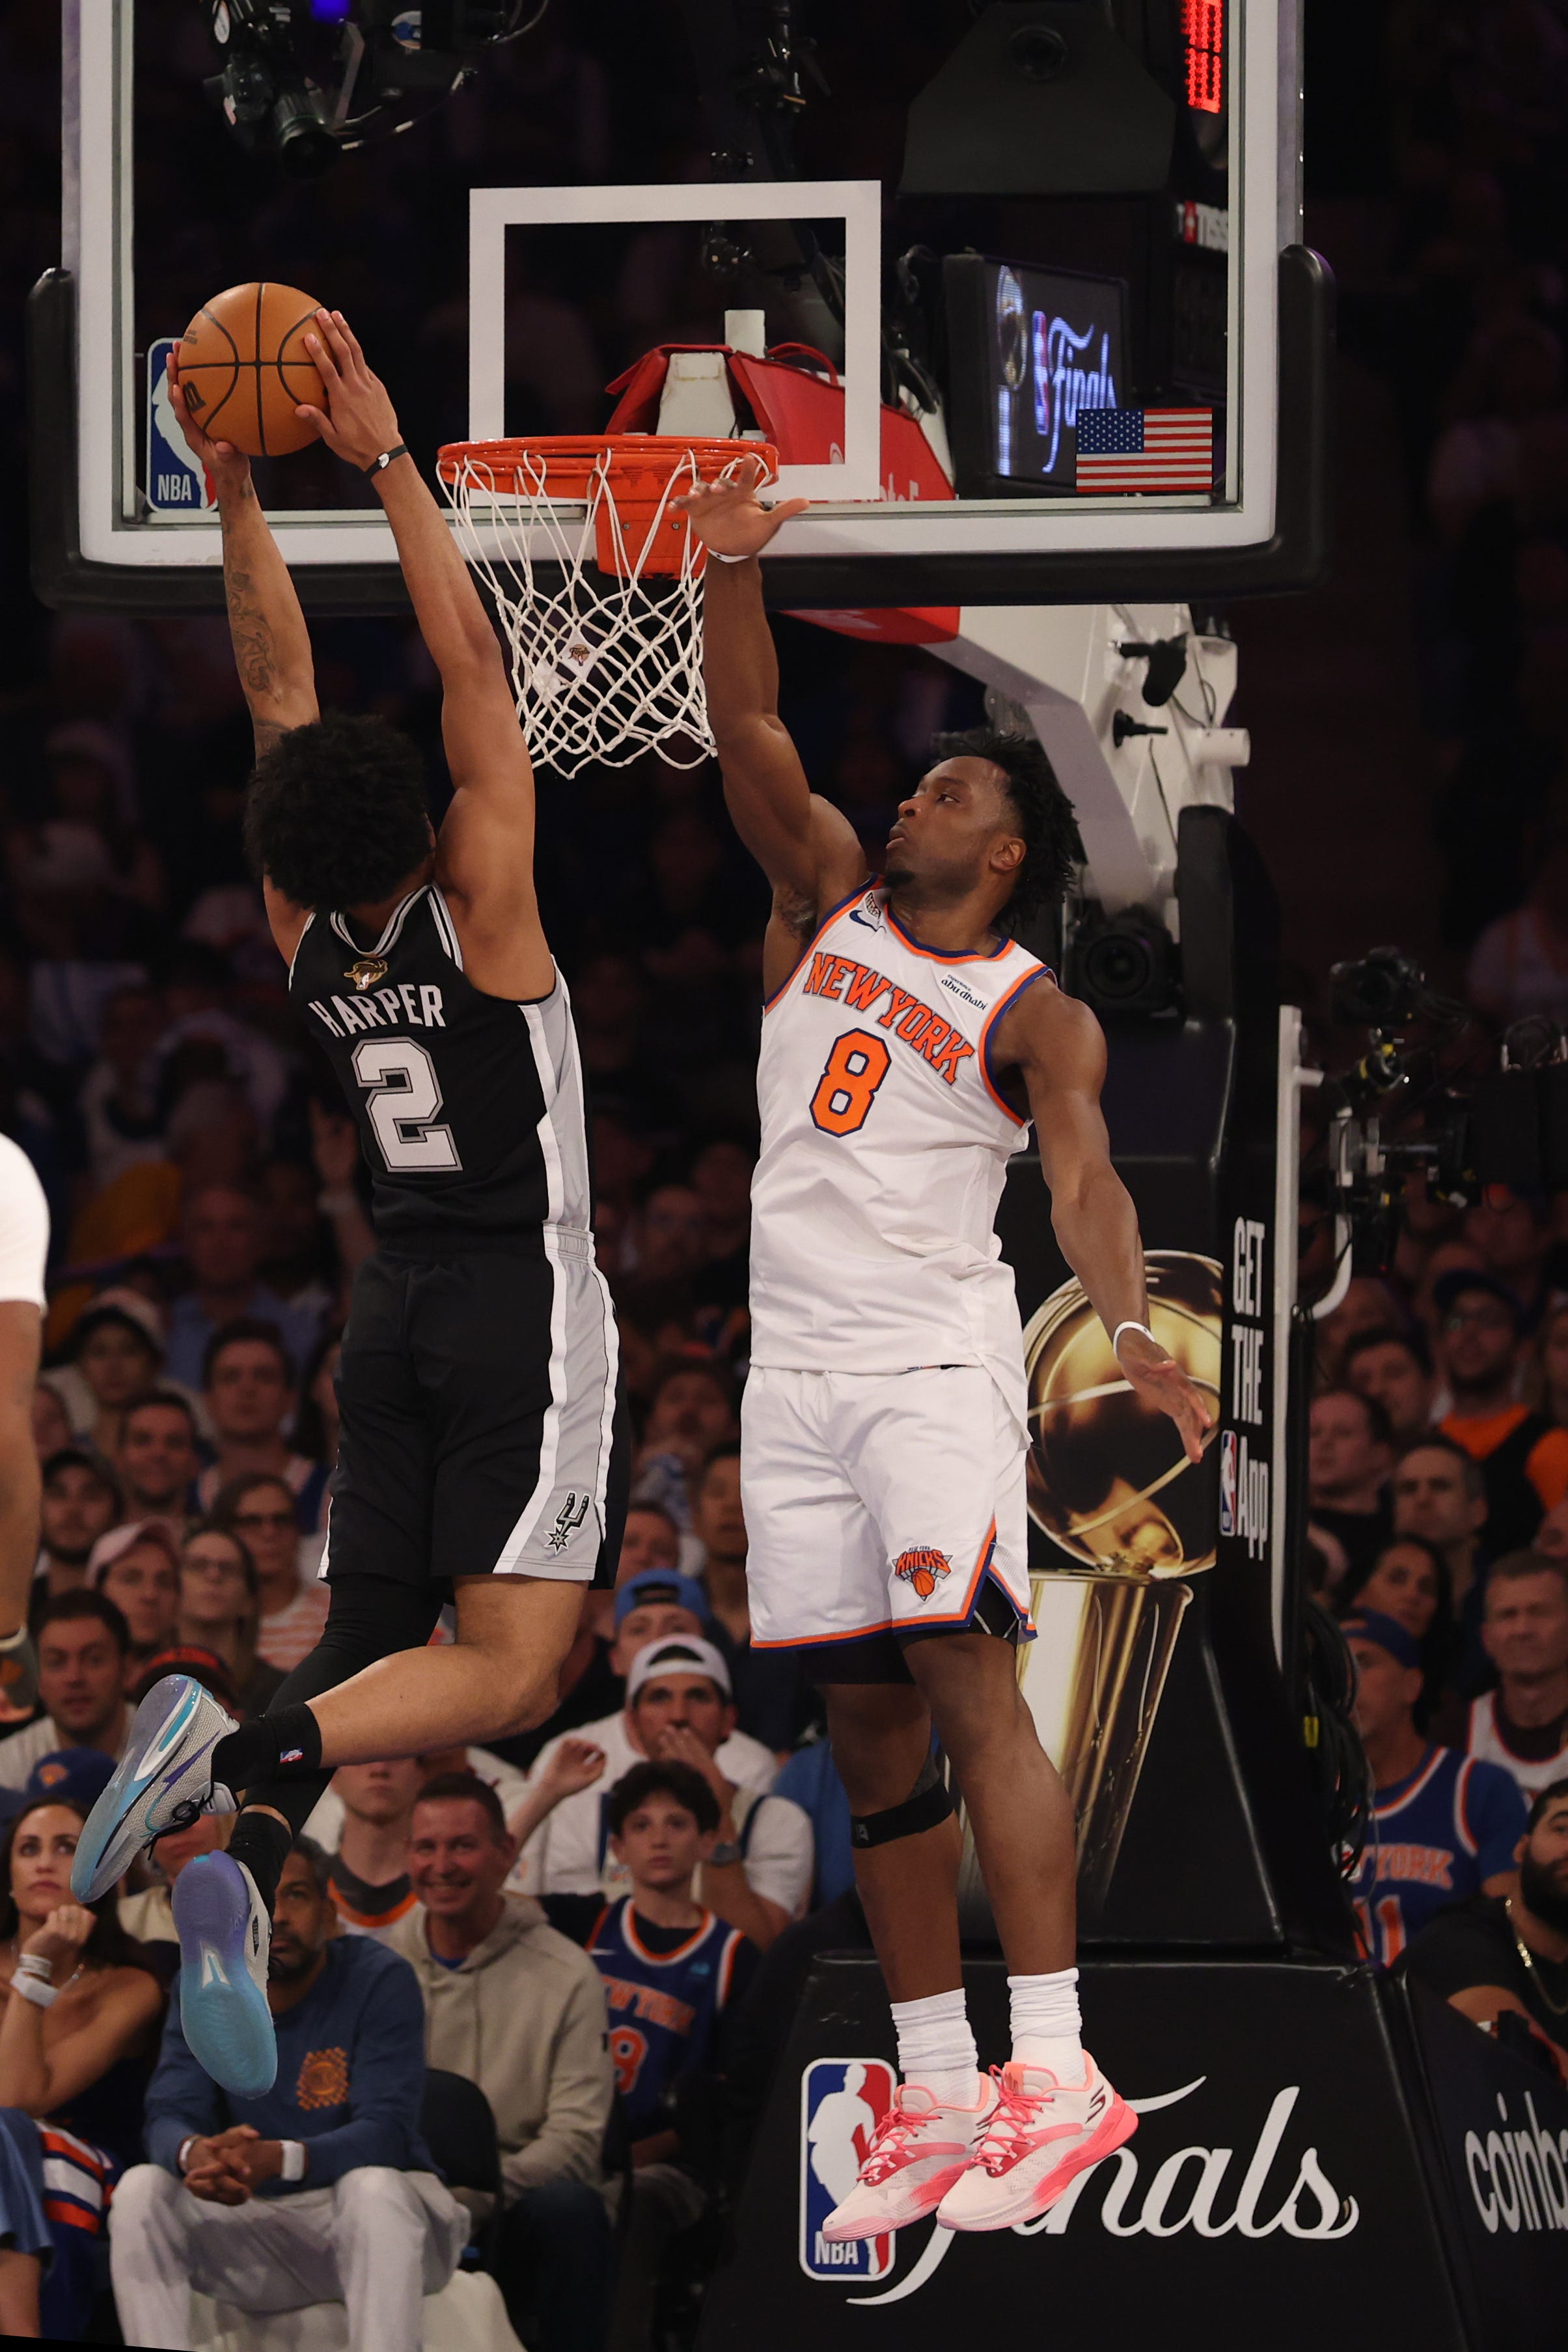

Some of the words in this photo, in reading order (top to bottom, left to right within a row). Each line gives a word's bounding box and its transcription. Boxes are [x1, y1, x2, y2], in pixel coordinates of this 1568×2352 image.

[158, 473, 193, 502] NBA
[307, 984, 447, 1038] HARPER
[803, 951, 892, 1014] NEW
[875, 986, 976, 1086] YORK
[941, 979, 960, 994] abu
[959, 990, 989, 1011] dhabi
[350, 1036, 463, 1172] 2
[809, 1027, 892, 1138] 8
[1233, 1216, 1265, 1318] GET
[1231, 1323, 1265, 1425] THE
[1237, 1435, 1269, 1560] App
[895, 1549, 951, 1576] KNICKS
[814, 2230, 859, 2265] NBA
